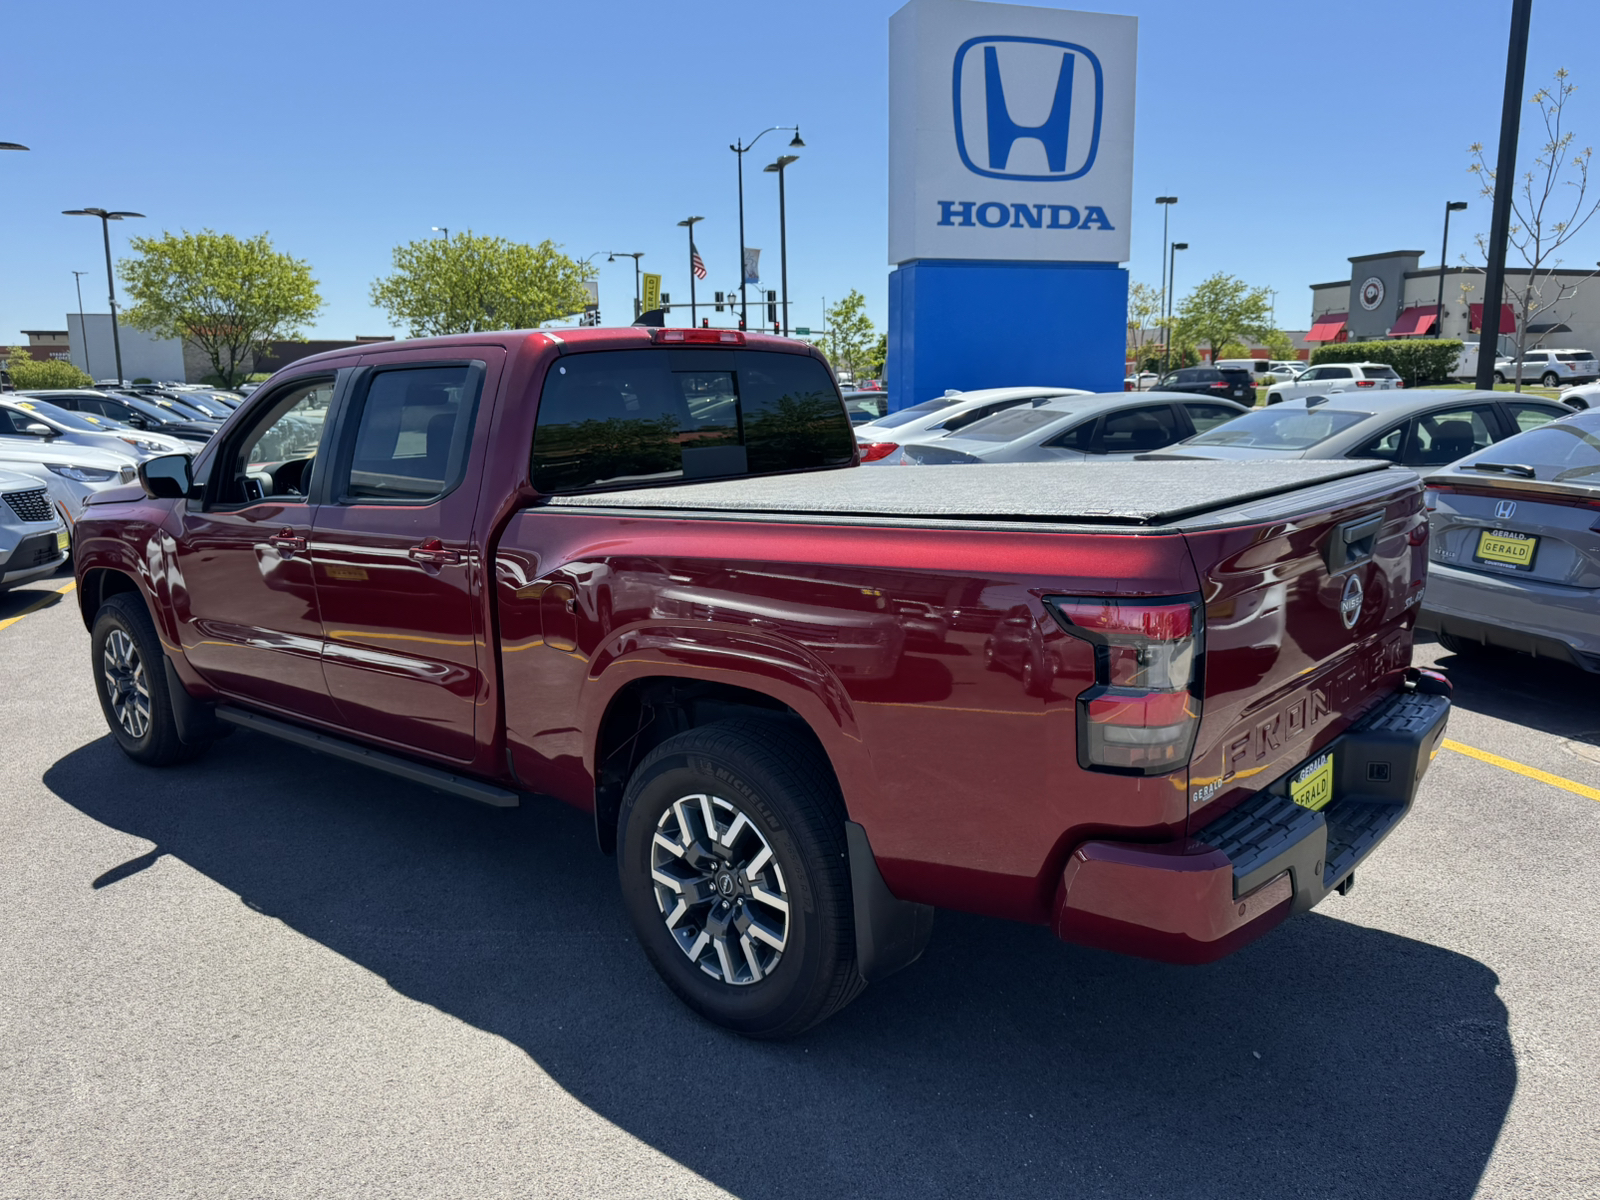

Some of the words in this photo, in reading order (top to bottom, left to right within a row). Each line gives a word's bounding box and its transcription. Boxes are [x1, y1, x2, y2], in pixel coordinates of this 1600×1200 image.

[937, 200, 1116, 231] HONDA
[647, 279, 655, 310] ERALD
[1492, 529, 1526, 540] GERALD
[1485, 542, 1526, 556] GERALD
[1342, 596, 1363, 611] NISS
[1222, 640, 1403, 780] FRONTIER
[1300, 754, 1327, 781] GERALD
[715, 767, 780, 828] MICHELIN
[1193, 778, 1223, 803] GERALD
